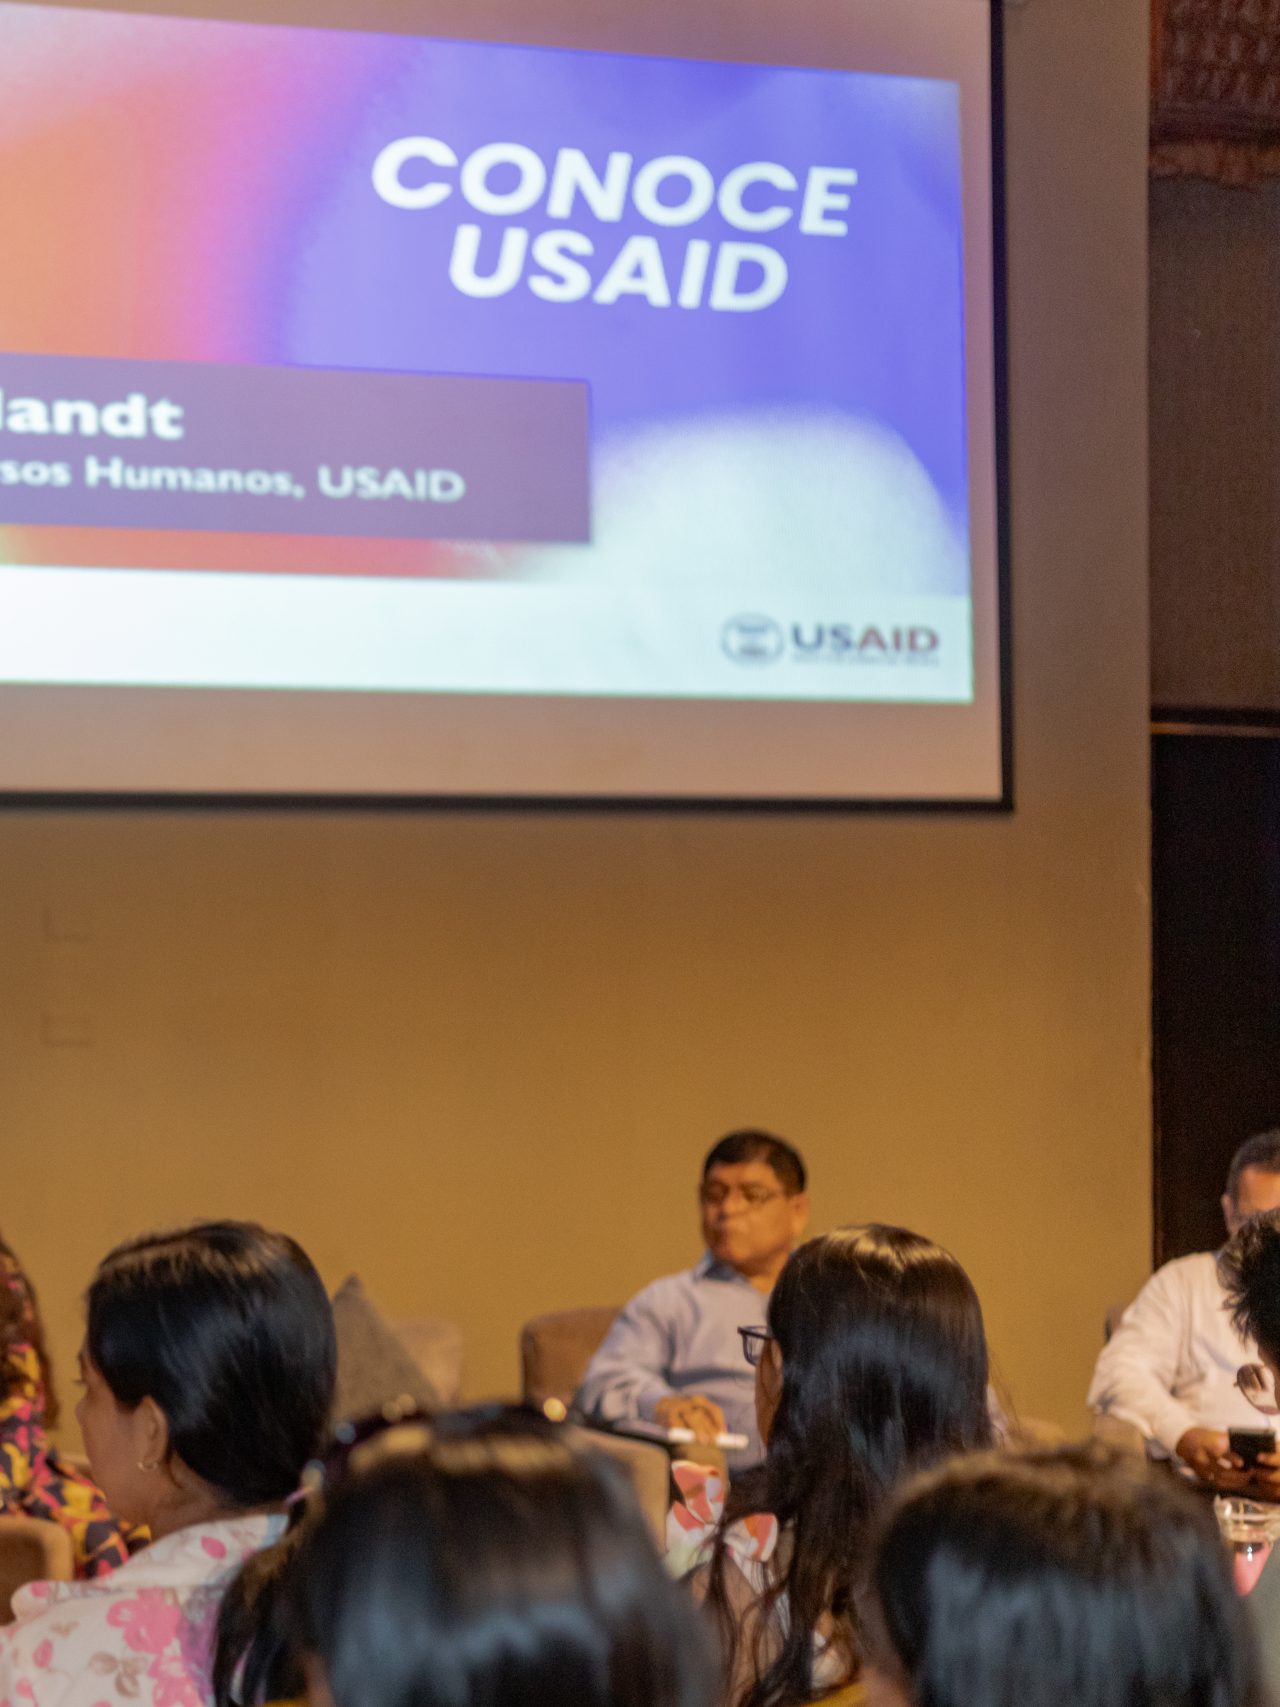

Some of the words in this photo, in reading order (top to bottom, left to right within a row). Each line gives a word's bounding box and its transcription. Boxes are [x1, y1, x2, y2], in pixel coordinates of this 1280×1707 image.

[371, 135, 858, 237] CONOCE
[449, 223, 789, 312] USAID
[85, 456, 306, 500] Humanos,
[318, 465, 466, 502] USAID
[792, 622, 940, 653] USAID
